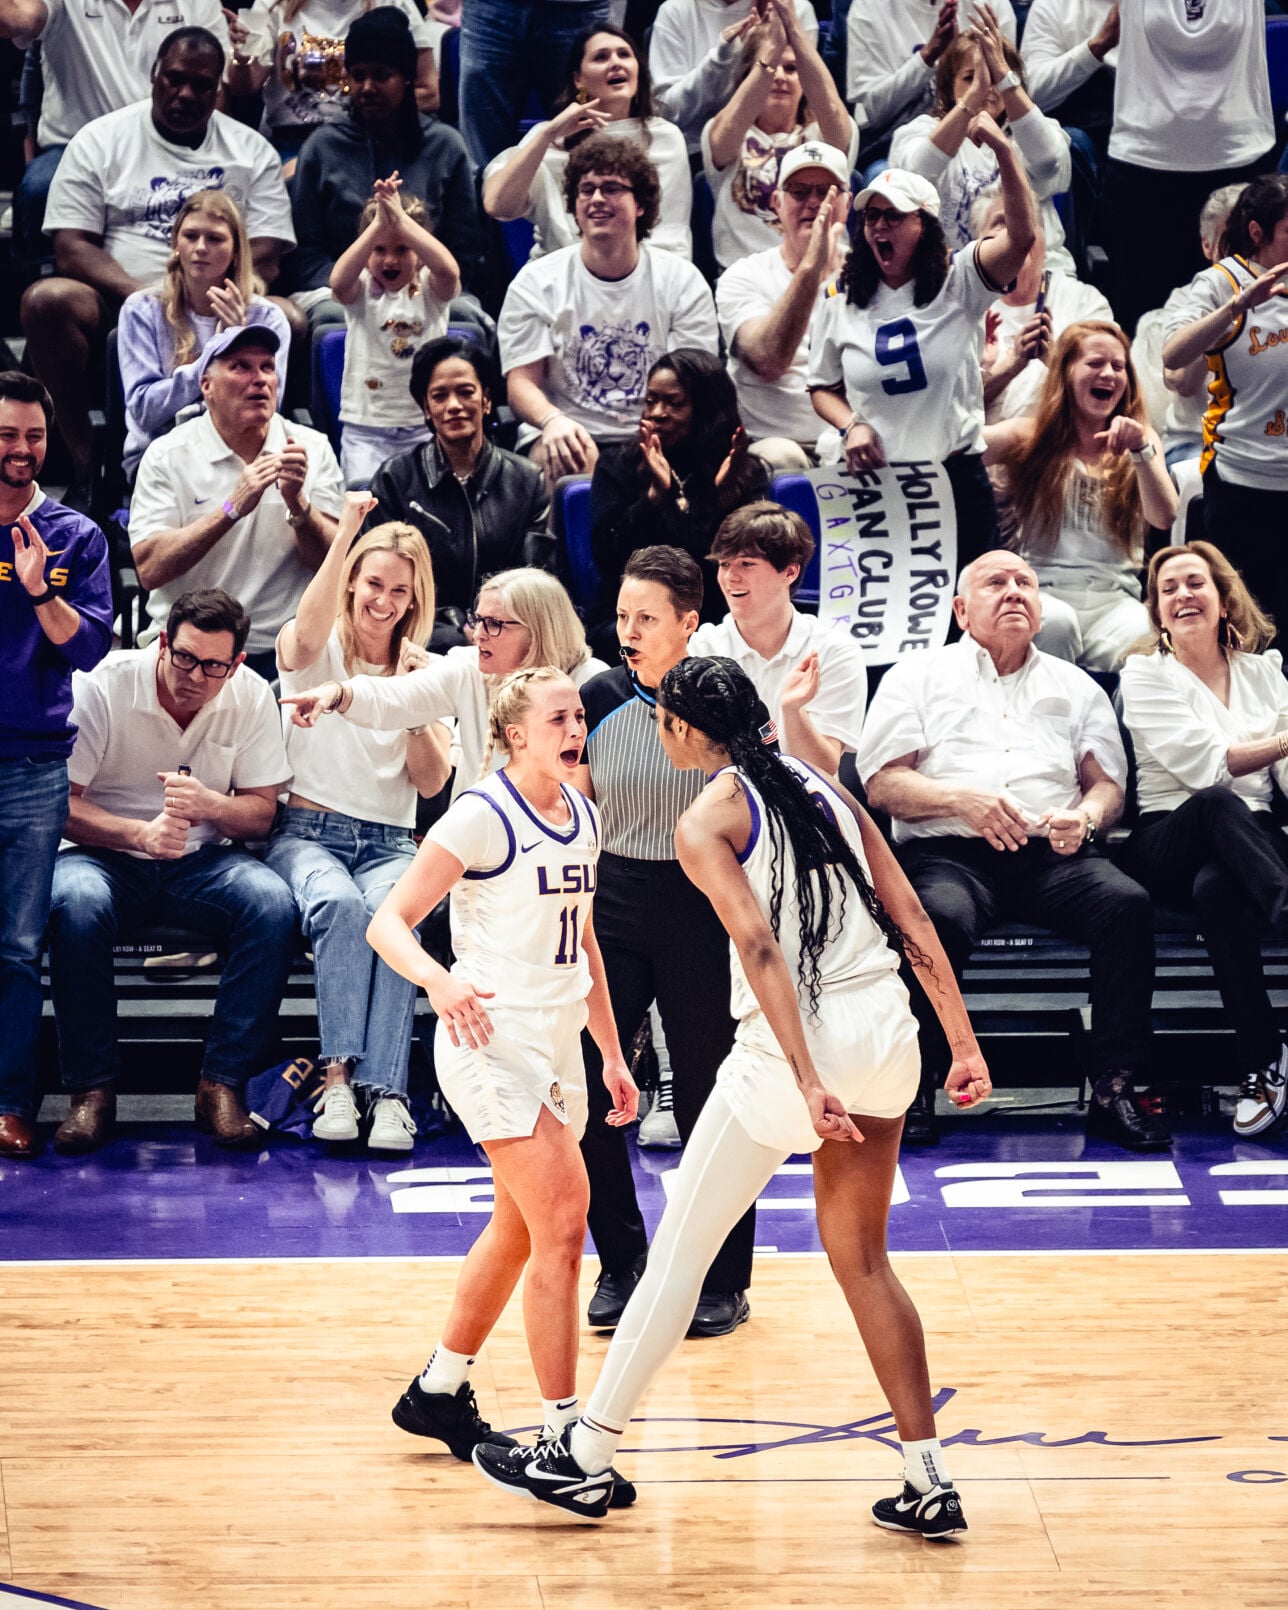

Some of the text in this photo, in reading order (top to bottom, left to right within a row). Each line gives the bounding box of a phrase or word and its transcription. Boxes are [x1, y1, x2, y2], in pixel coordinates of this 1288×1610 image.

[875, 317, 928, 396] 9
[837, 468, 890, 539] FAN
[0, 561, 69, 587] ES
[888, 460, 950, 653] HOLLY ROWE
[537, 864, 596, 895] LSU
[554, 905, 579, 965] 11
